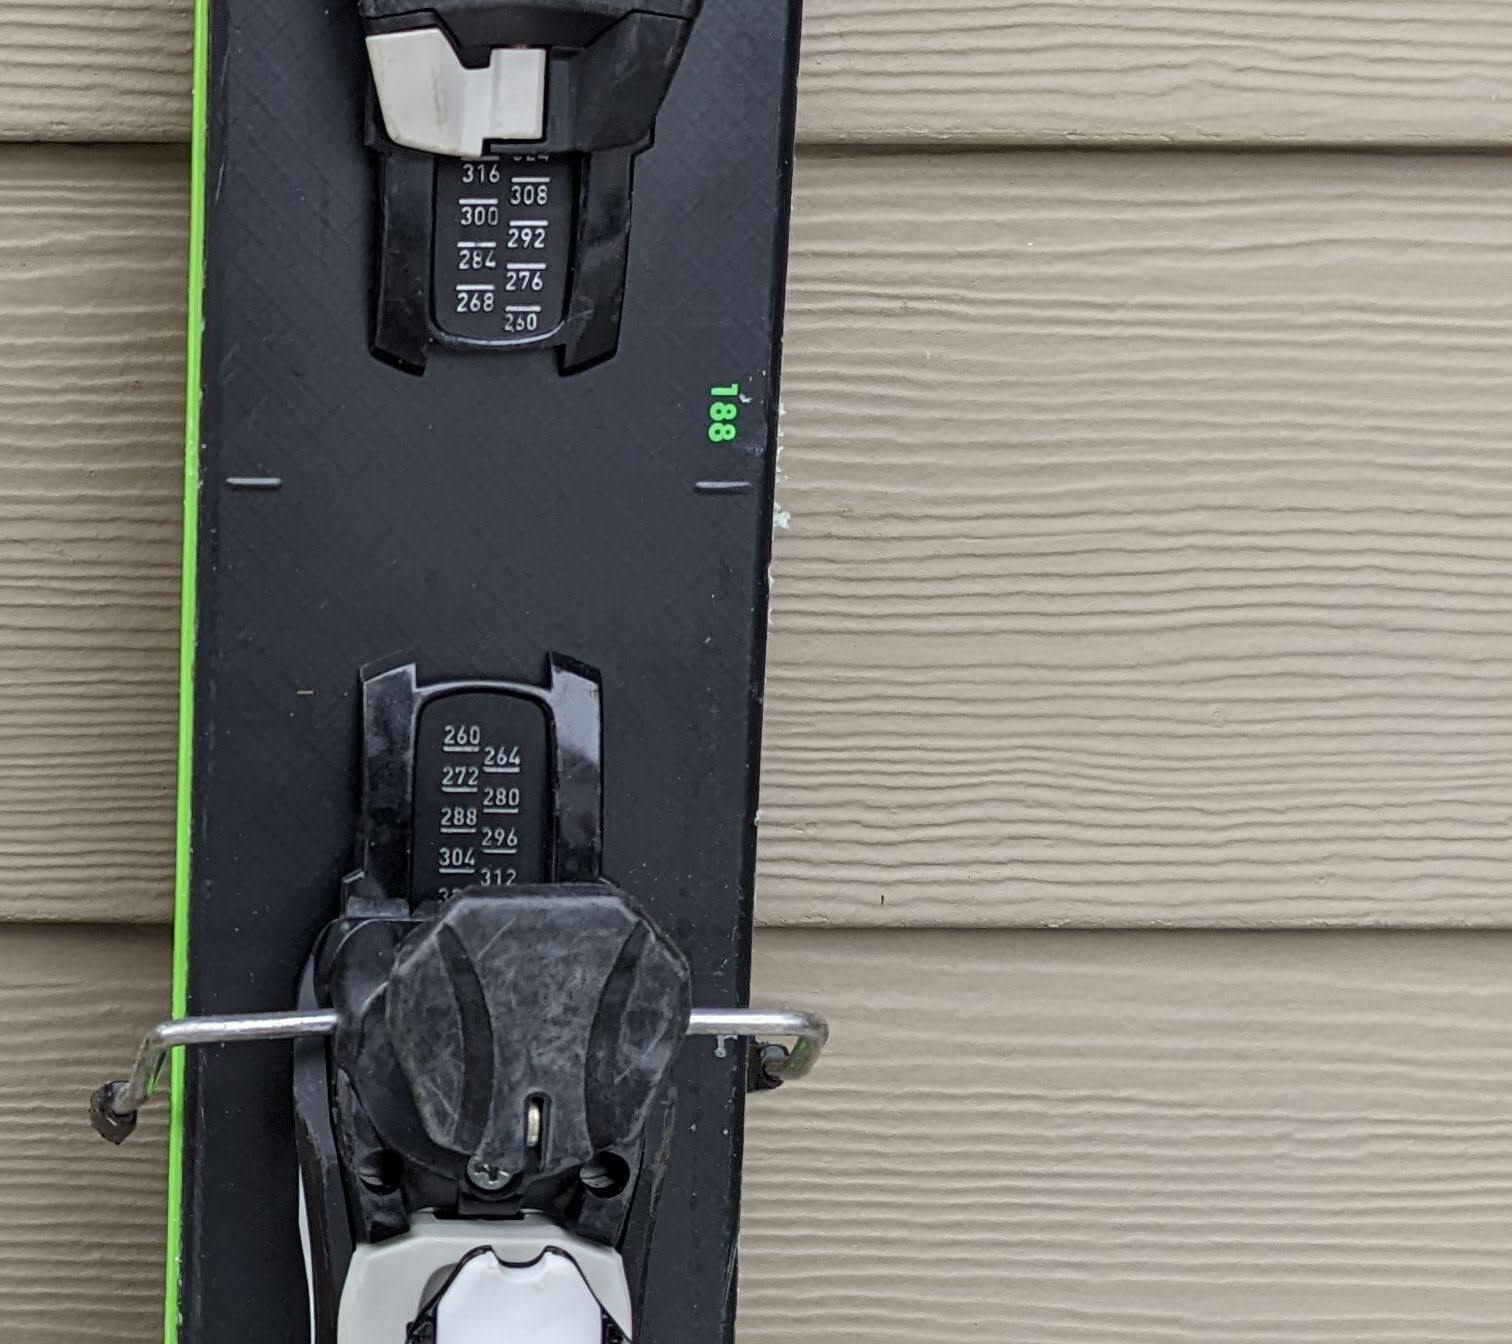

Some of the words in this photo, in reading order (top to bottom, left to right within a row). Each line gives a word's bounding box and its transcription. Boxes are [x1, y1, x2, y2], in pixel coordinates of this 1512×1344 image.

[462, 164, 500, 183] 316
[510, 185, 548, 205] 308
[460, 207, 499, 226] 300
[507, 229, 546, 248] 292
[458, 250, 497, 270] 284
[505, 272, 543, 291] 276
[456, 293, 495, 313] 268
[504, 314, 538, 332] 260
[708, 384, 738, 442] 188
[443, 725, 481, 745] 260
[484, 746, 521, 765] 264
[442, 766, 479, 785] 272
[483, 788, 520, 806] 280
[440, 807, 478, 826] 288
[482, 827, 518, 846] 296
[439, 847, 475, 866] 304
[480, 868, 517, 886] 312
